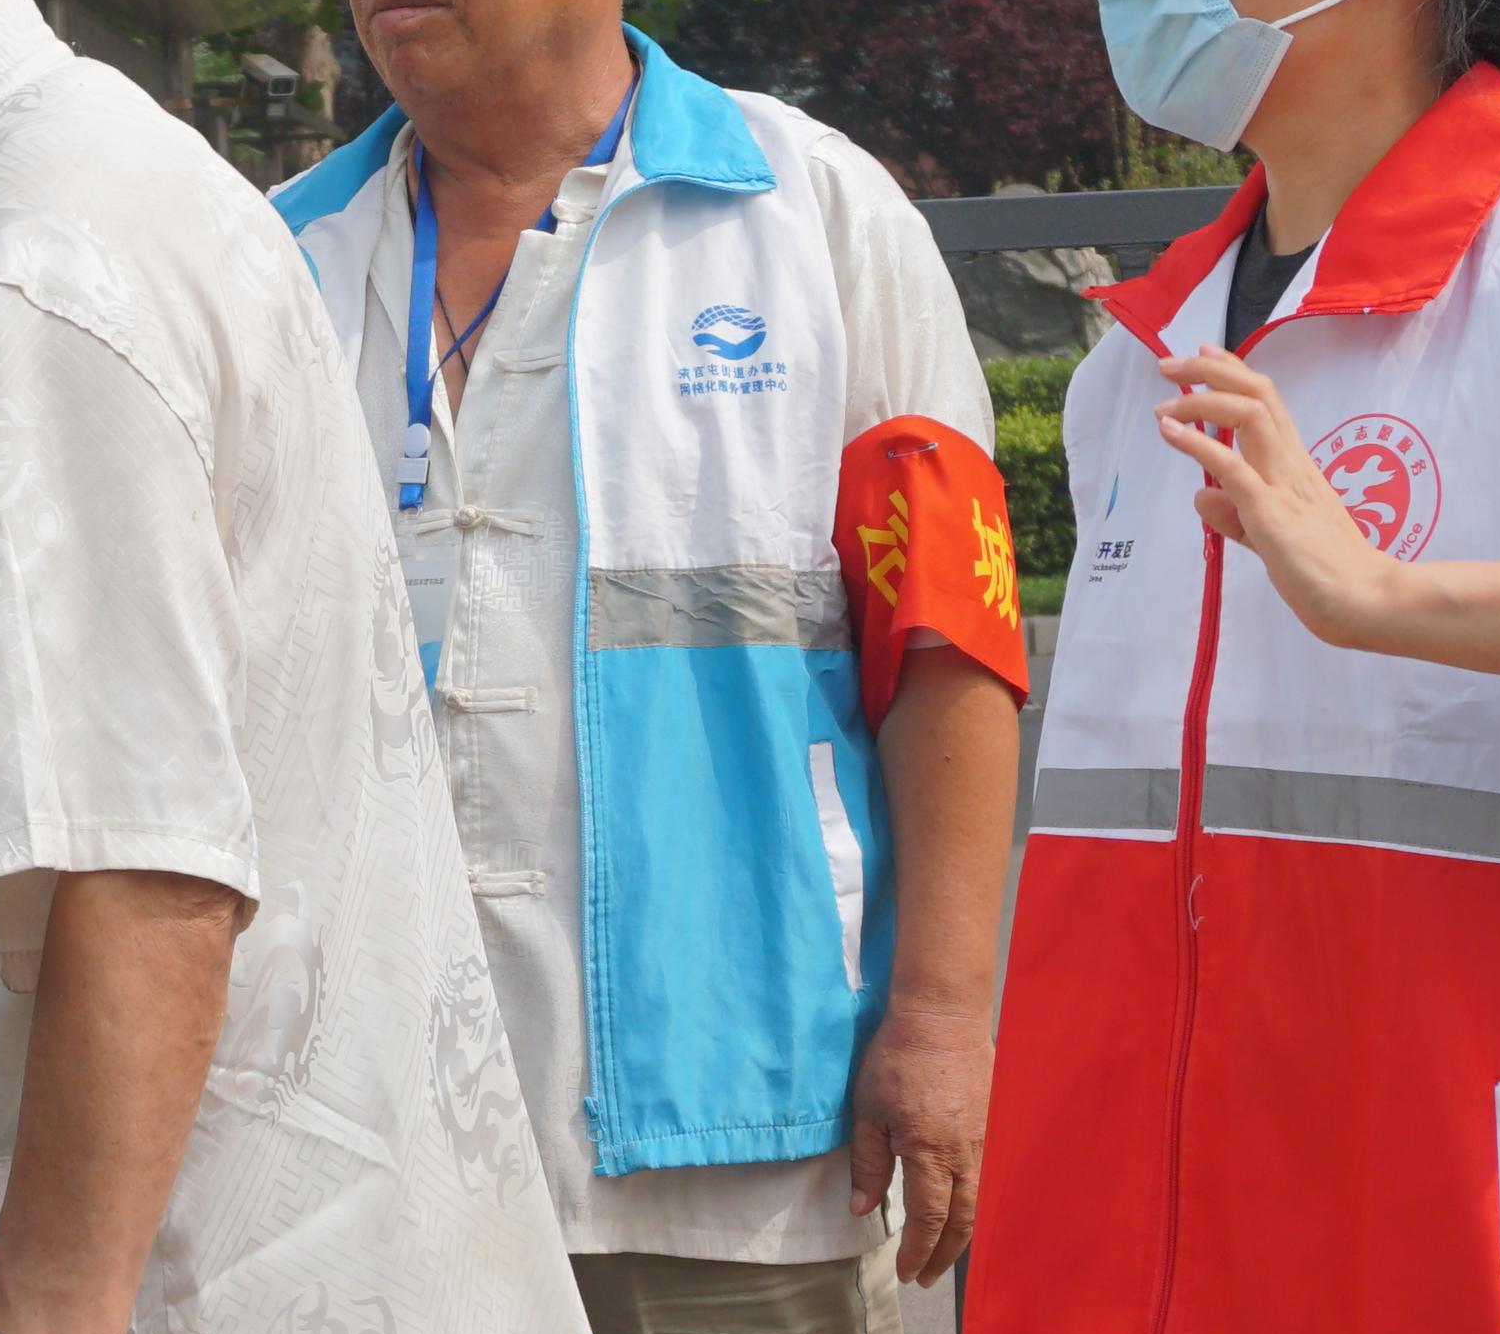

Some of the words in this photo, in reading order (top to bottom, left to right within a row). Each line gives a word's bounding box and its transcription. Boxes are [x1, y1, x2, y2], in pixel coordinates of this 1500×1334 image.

[680, 379, 788, 396] 网格化服务管理中心
[971, 497, 1018, 631] 城
